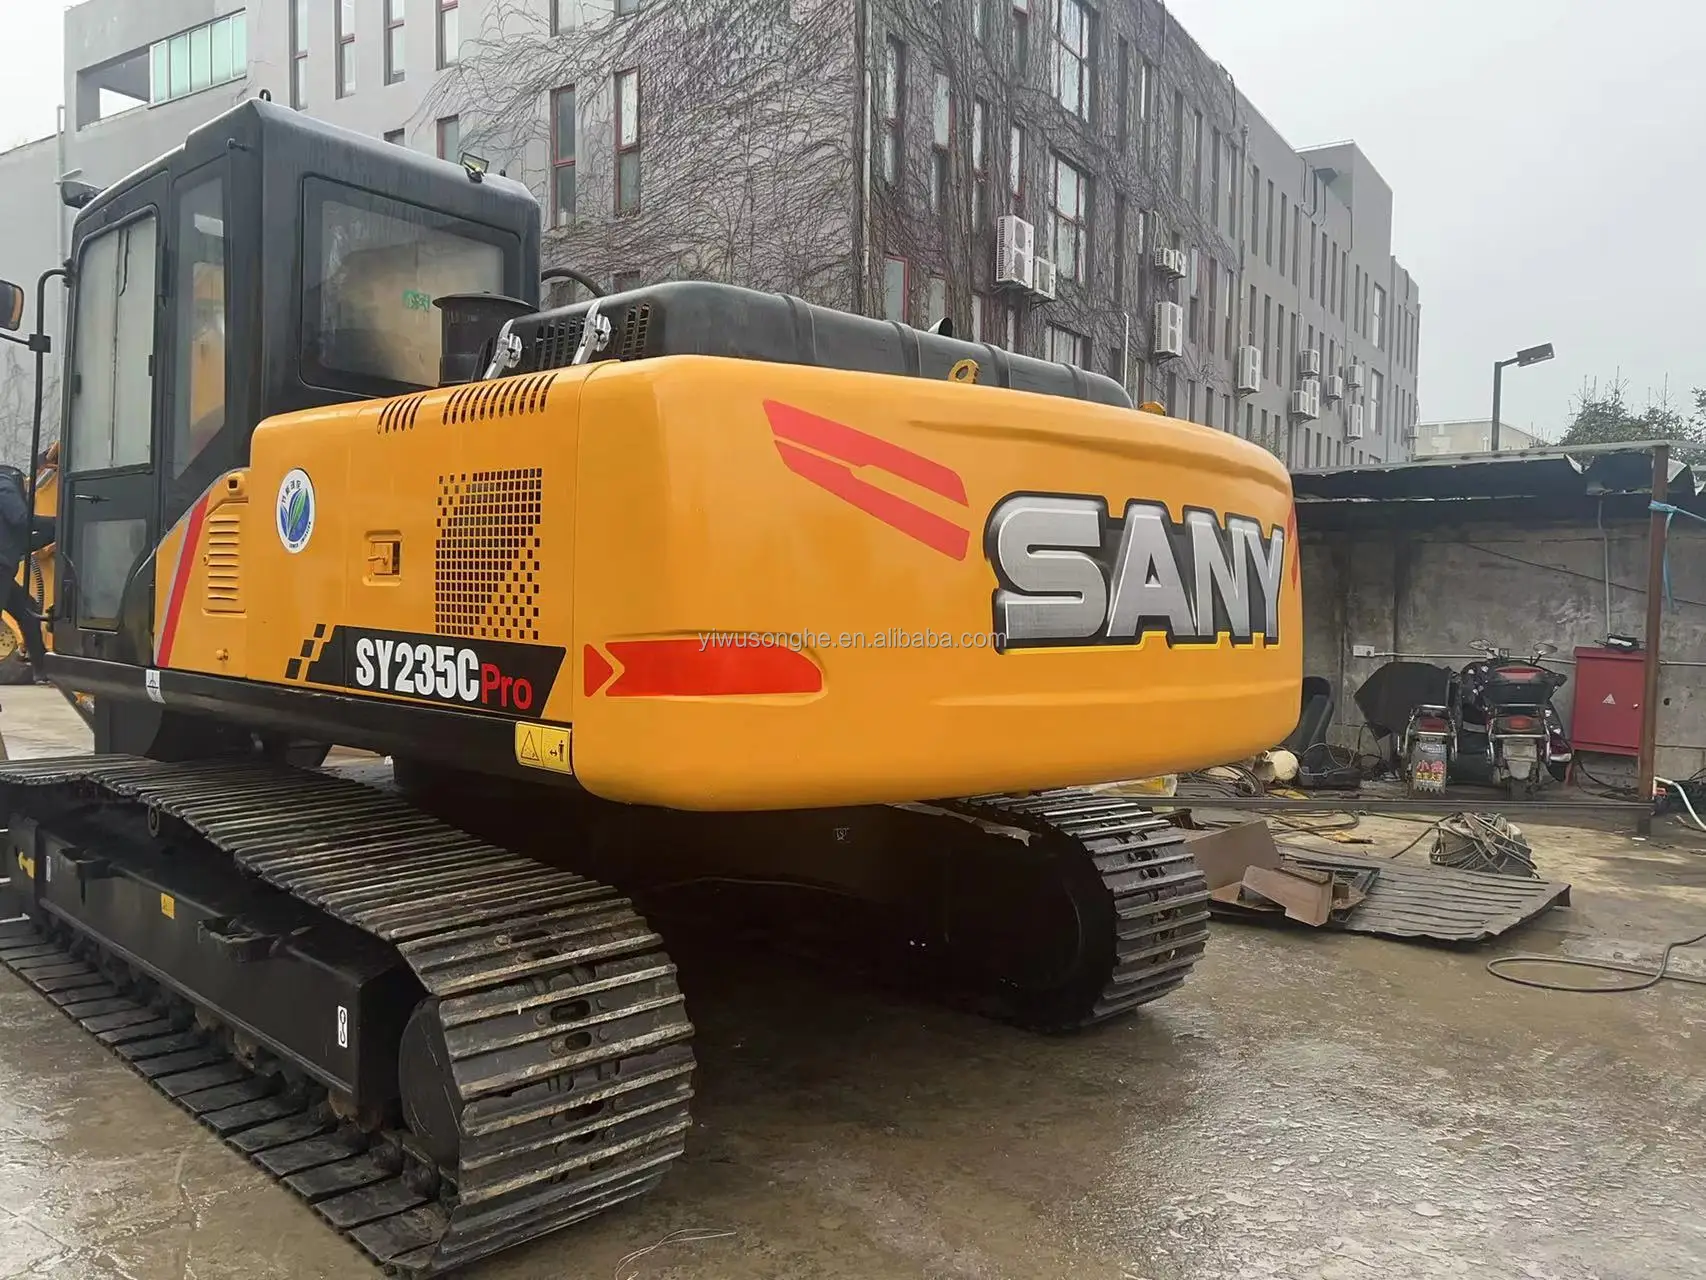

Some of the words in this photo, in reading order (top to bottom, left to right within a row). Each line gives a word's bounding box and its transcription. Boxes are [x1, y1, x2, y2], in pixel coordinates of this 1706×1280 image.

[990, 494, 1284, 640] SANY
[356, 637, 479, 702] SY235C
[481, 663, 533, 710] Pro
